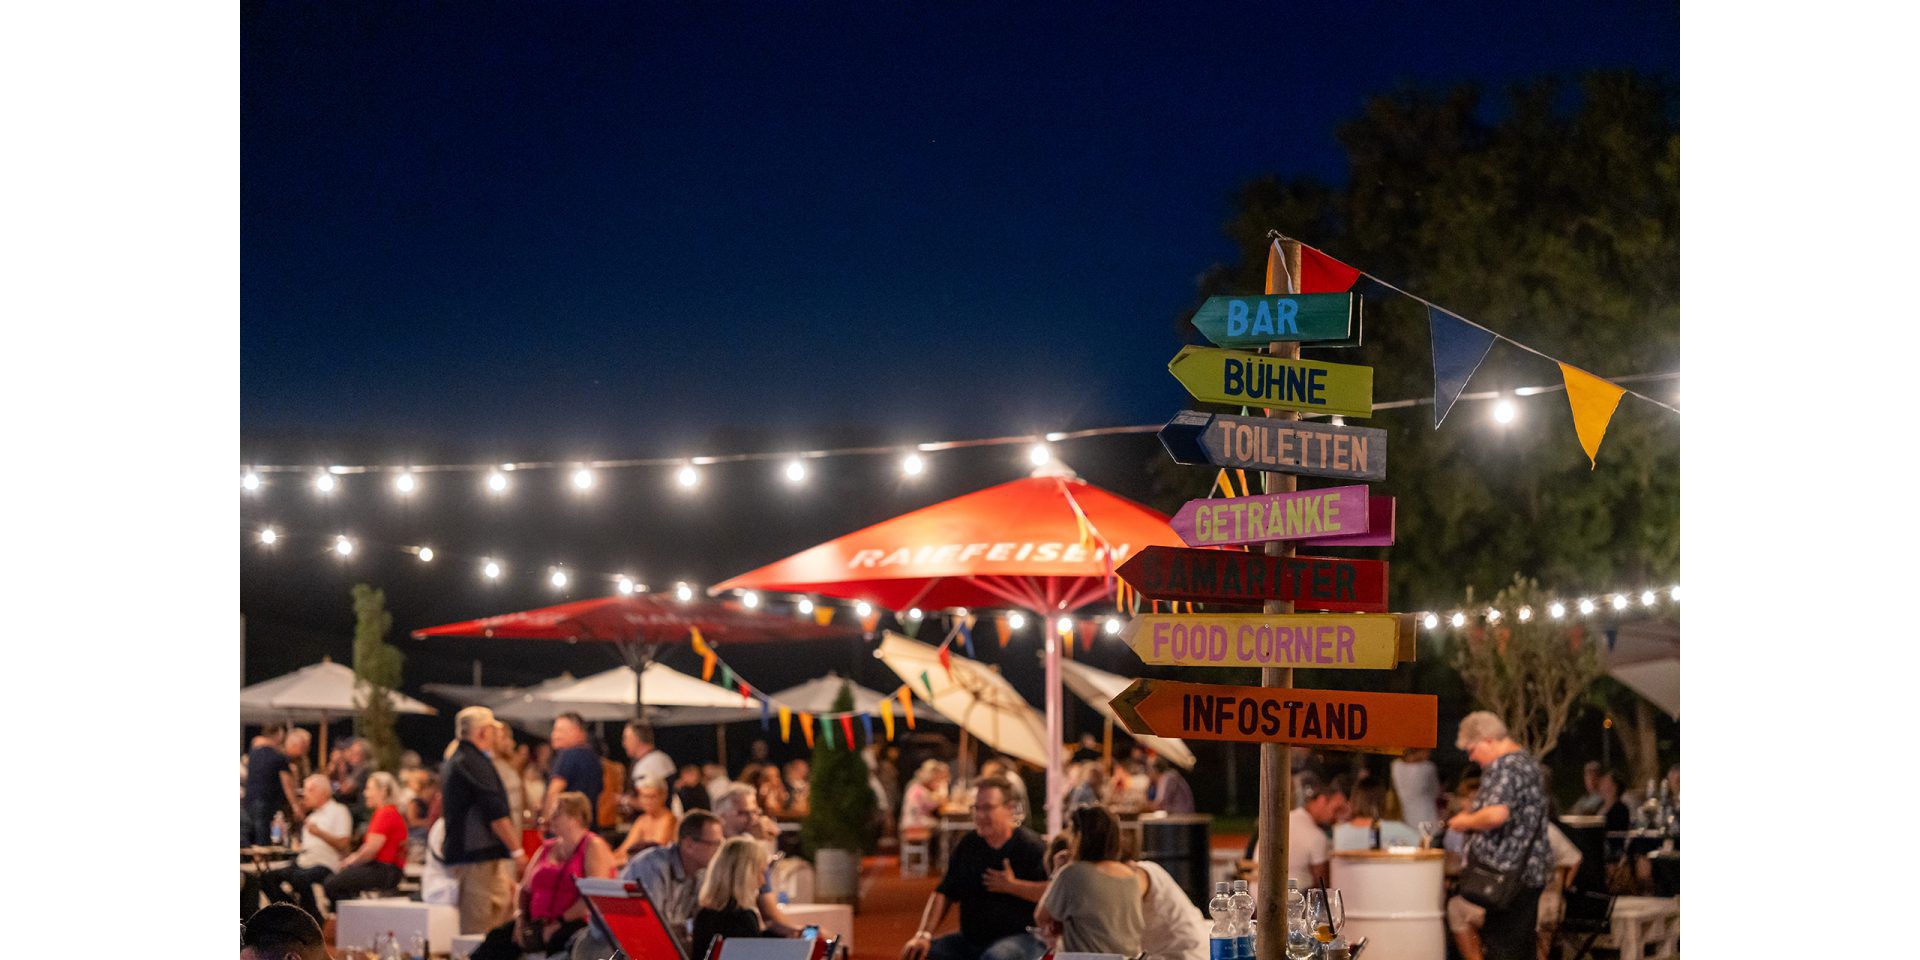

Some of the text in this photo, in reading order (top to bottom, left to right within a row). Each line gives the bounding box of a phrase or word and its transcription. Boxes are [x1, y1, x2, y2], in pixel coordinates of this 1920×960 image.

[1227, 299, 1299, 337] BAR
[1224, 358, 1328, 404] BÜHNE
[1218, 421, 1368, 472] TOILETTEN
[1195, 493, 1341, 542] GETRÄNKE
[848, 542, 1130, 569] RAIFFEISEN
[1143, 554, 1357, 600] SAMARITER
[1153, 622, 1356, 664] FOOD CORNER
[1182, 694, 1368, 740] INFOSTAND
